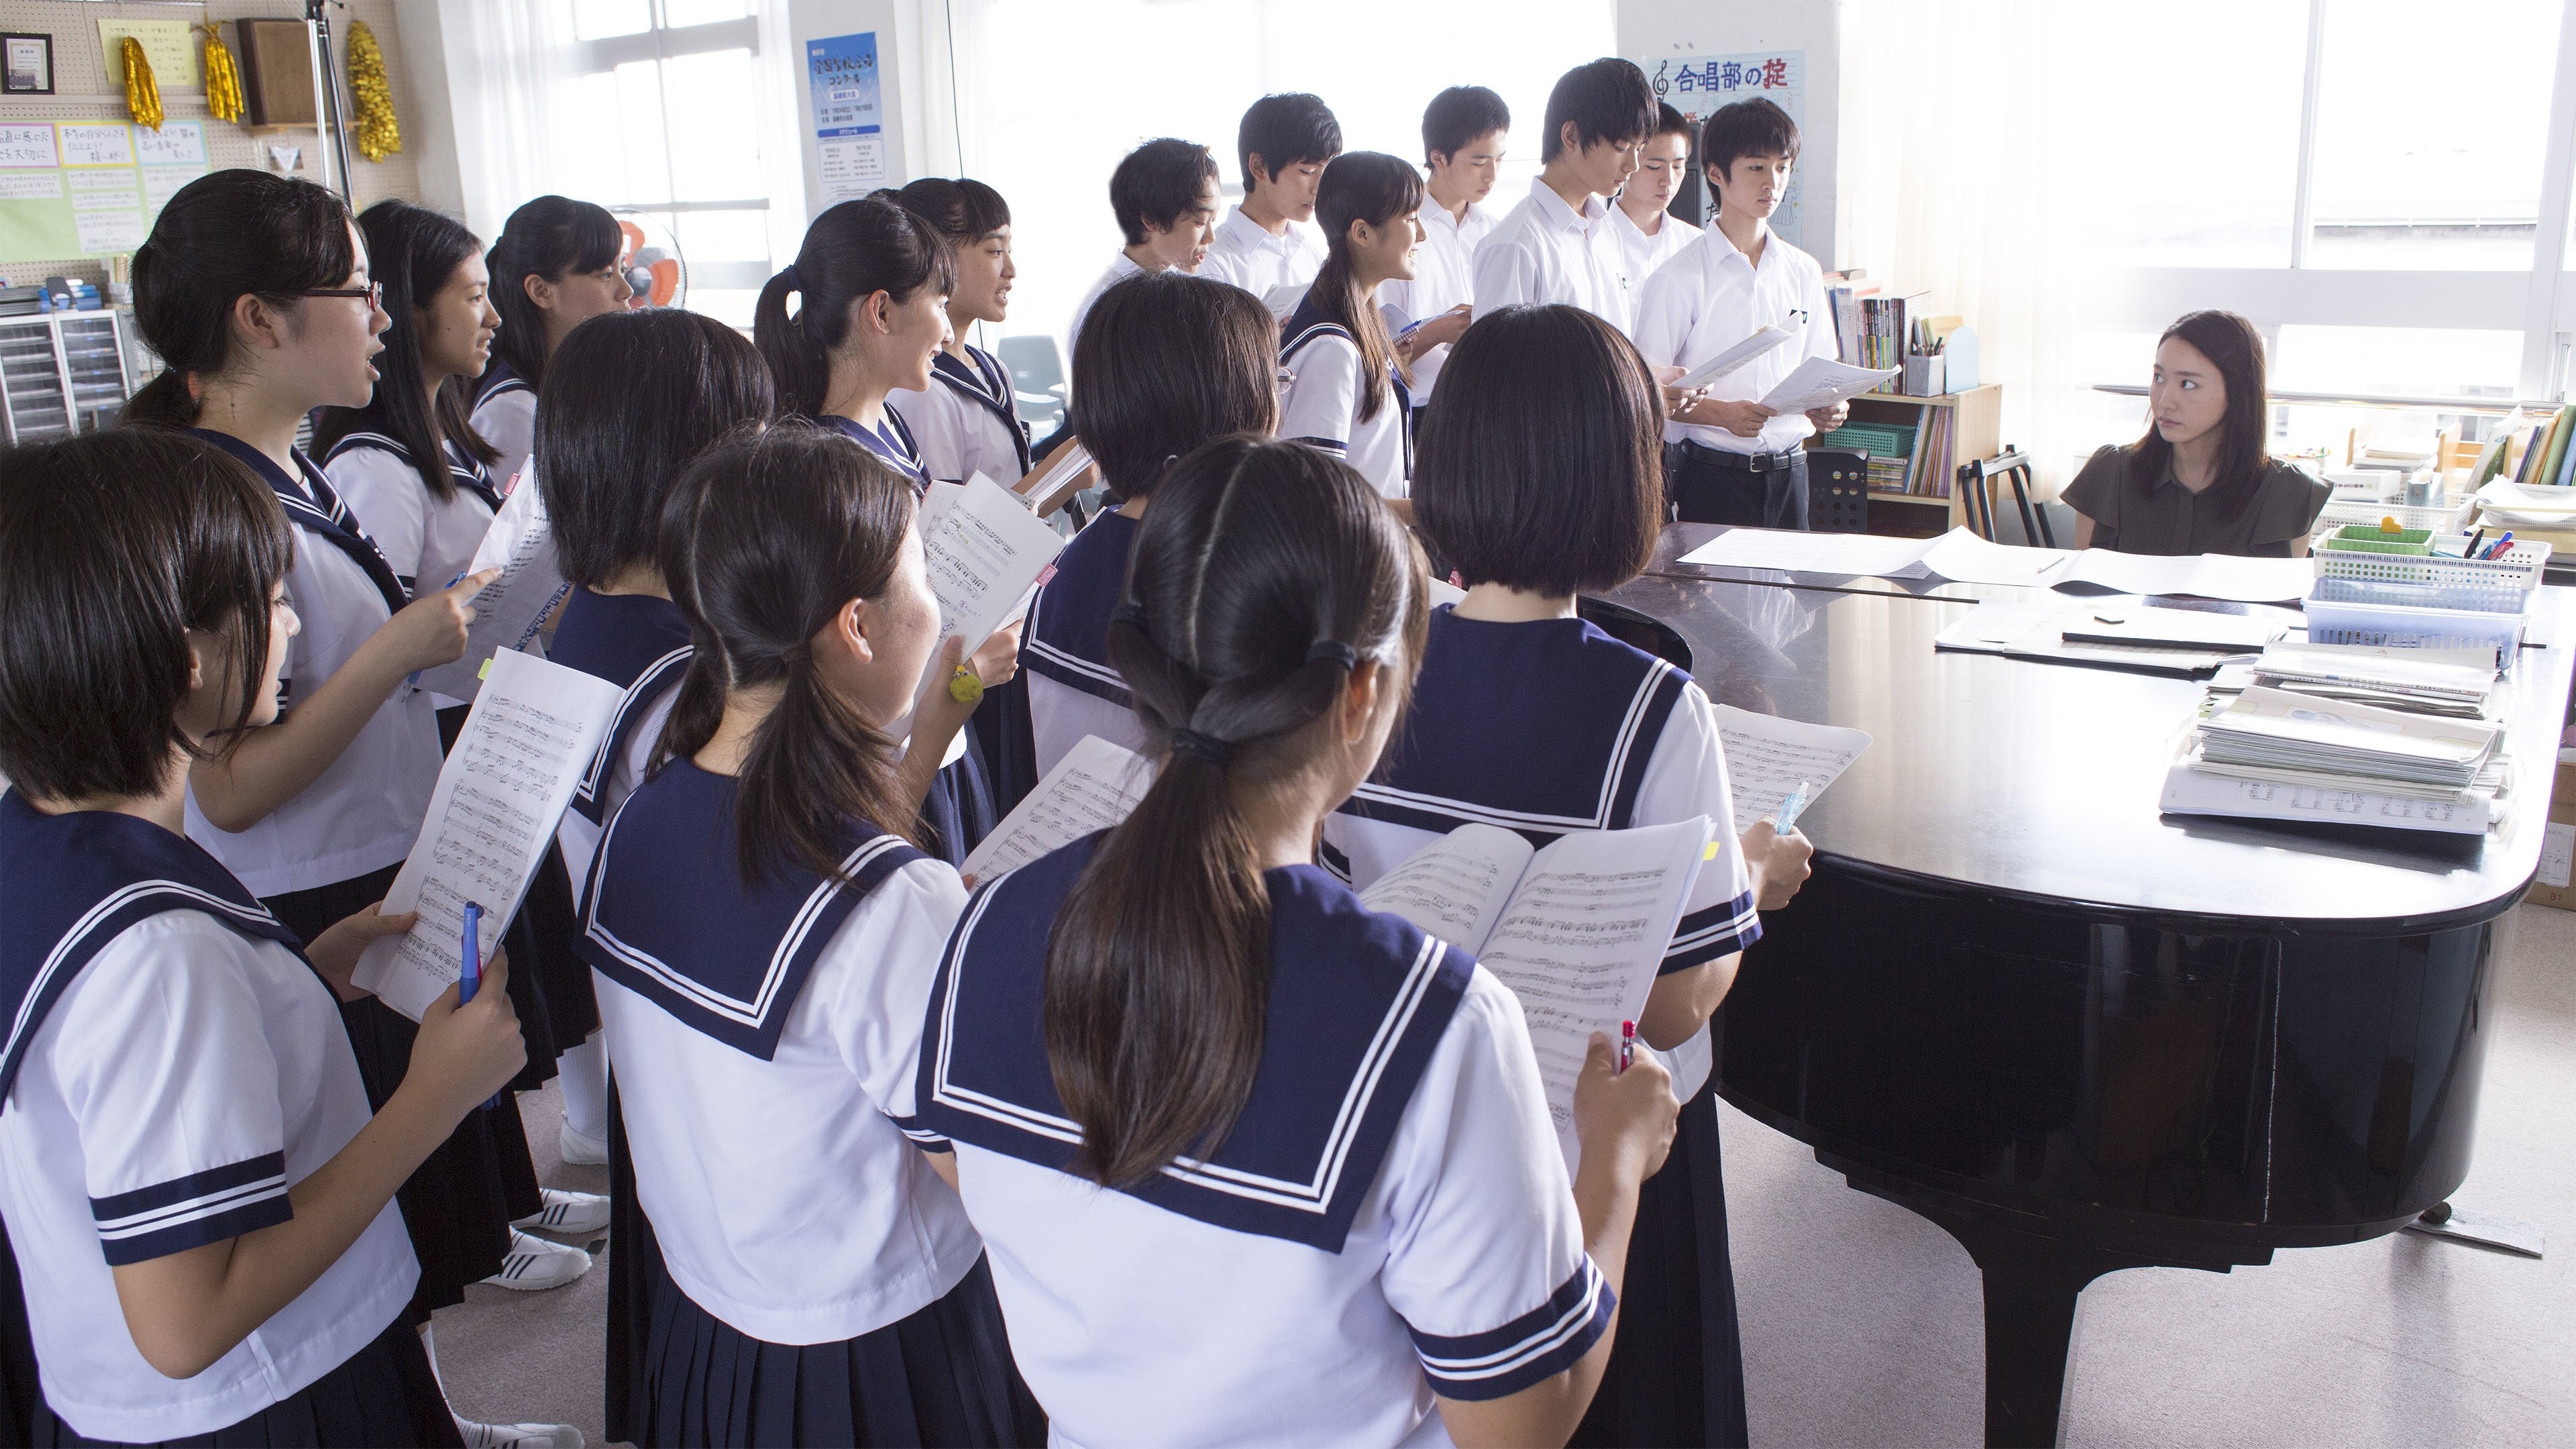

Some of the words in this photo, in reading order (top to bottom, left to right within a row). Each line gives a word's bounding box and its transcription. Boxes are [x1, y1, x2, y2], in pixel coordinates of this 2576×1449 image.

[1674, 58, 1788, 93] 合唱部の掟
[2550, 892, 2562, 902] B1
